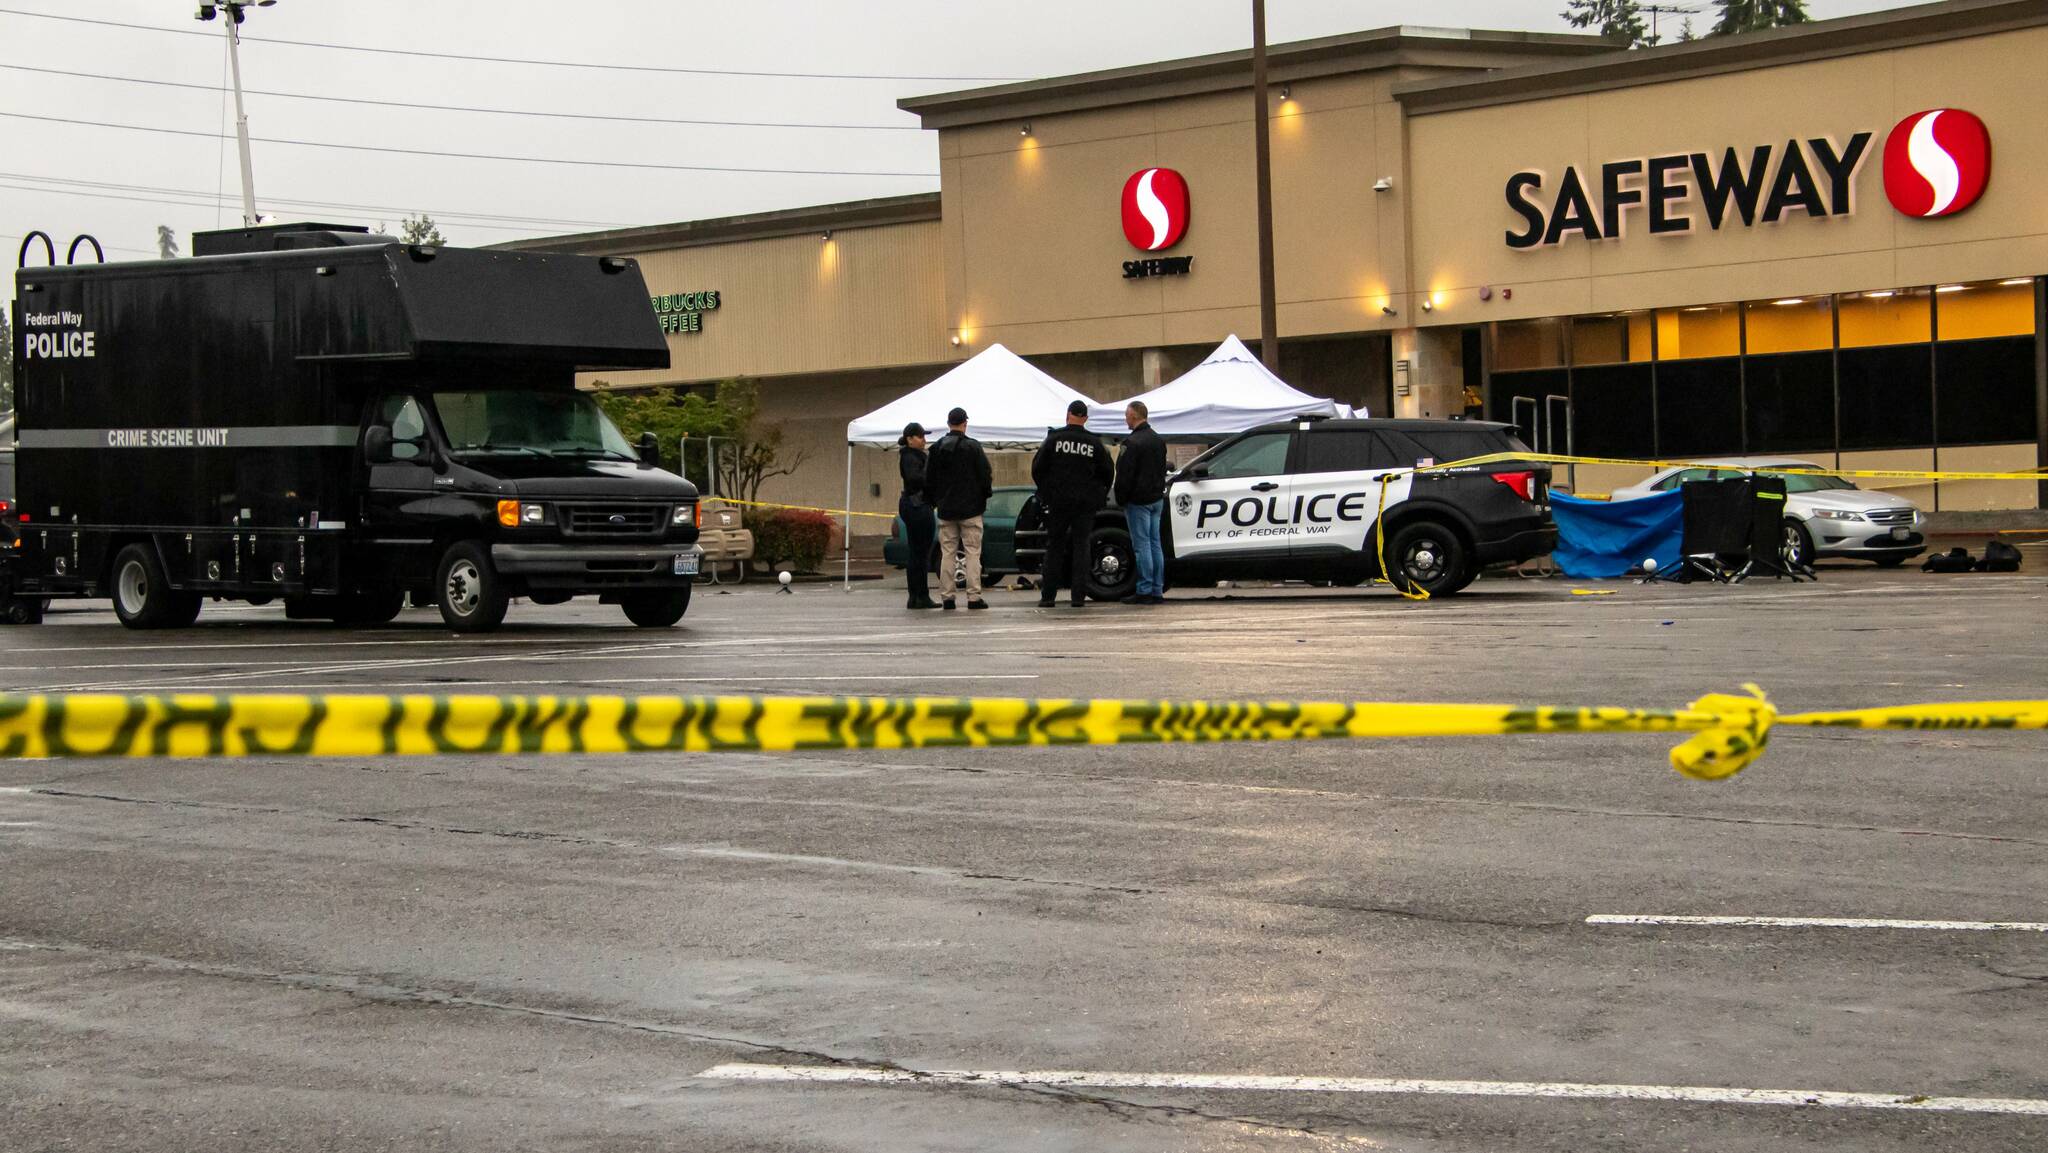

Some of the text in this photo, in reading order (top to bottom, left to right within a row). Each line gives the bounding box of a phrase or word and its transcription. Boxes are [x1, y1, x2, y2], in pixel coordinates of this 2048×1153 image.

[1504, 131, 1873, 249] SAFEWAY
[650, 290, 720, 313] RBUCKS
[25, 311, 82, 327] Federal Way
[660, 313, 702, 333] FFEE
[26, 331, 95, 358] POLICE
[108, 428, 228, 446] CRIME SCENE UNIT
[1055, 440, 1095, 458] POLICE
[1196, 491, 1367, 529] POLICE
[1196, 525, 1331, 540] CITY OF FEDERAL WAY
